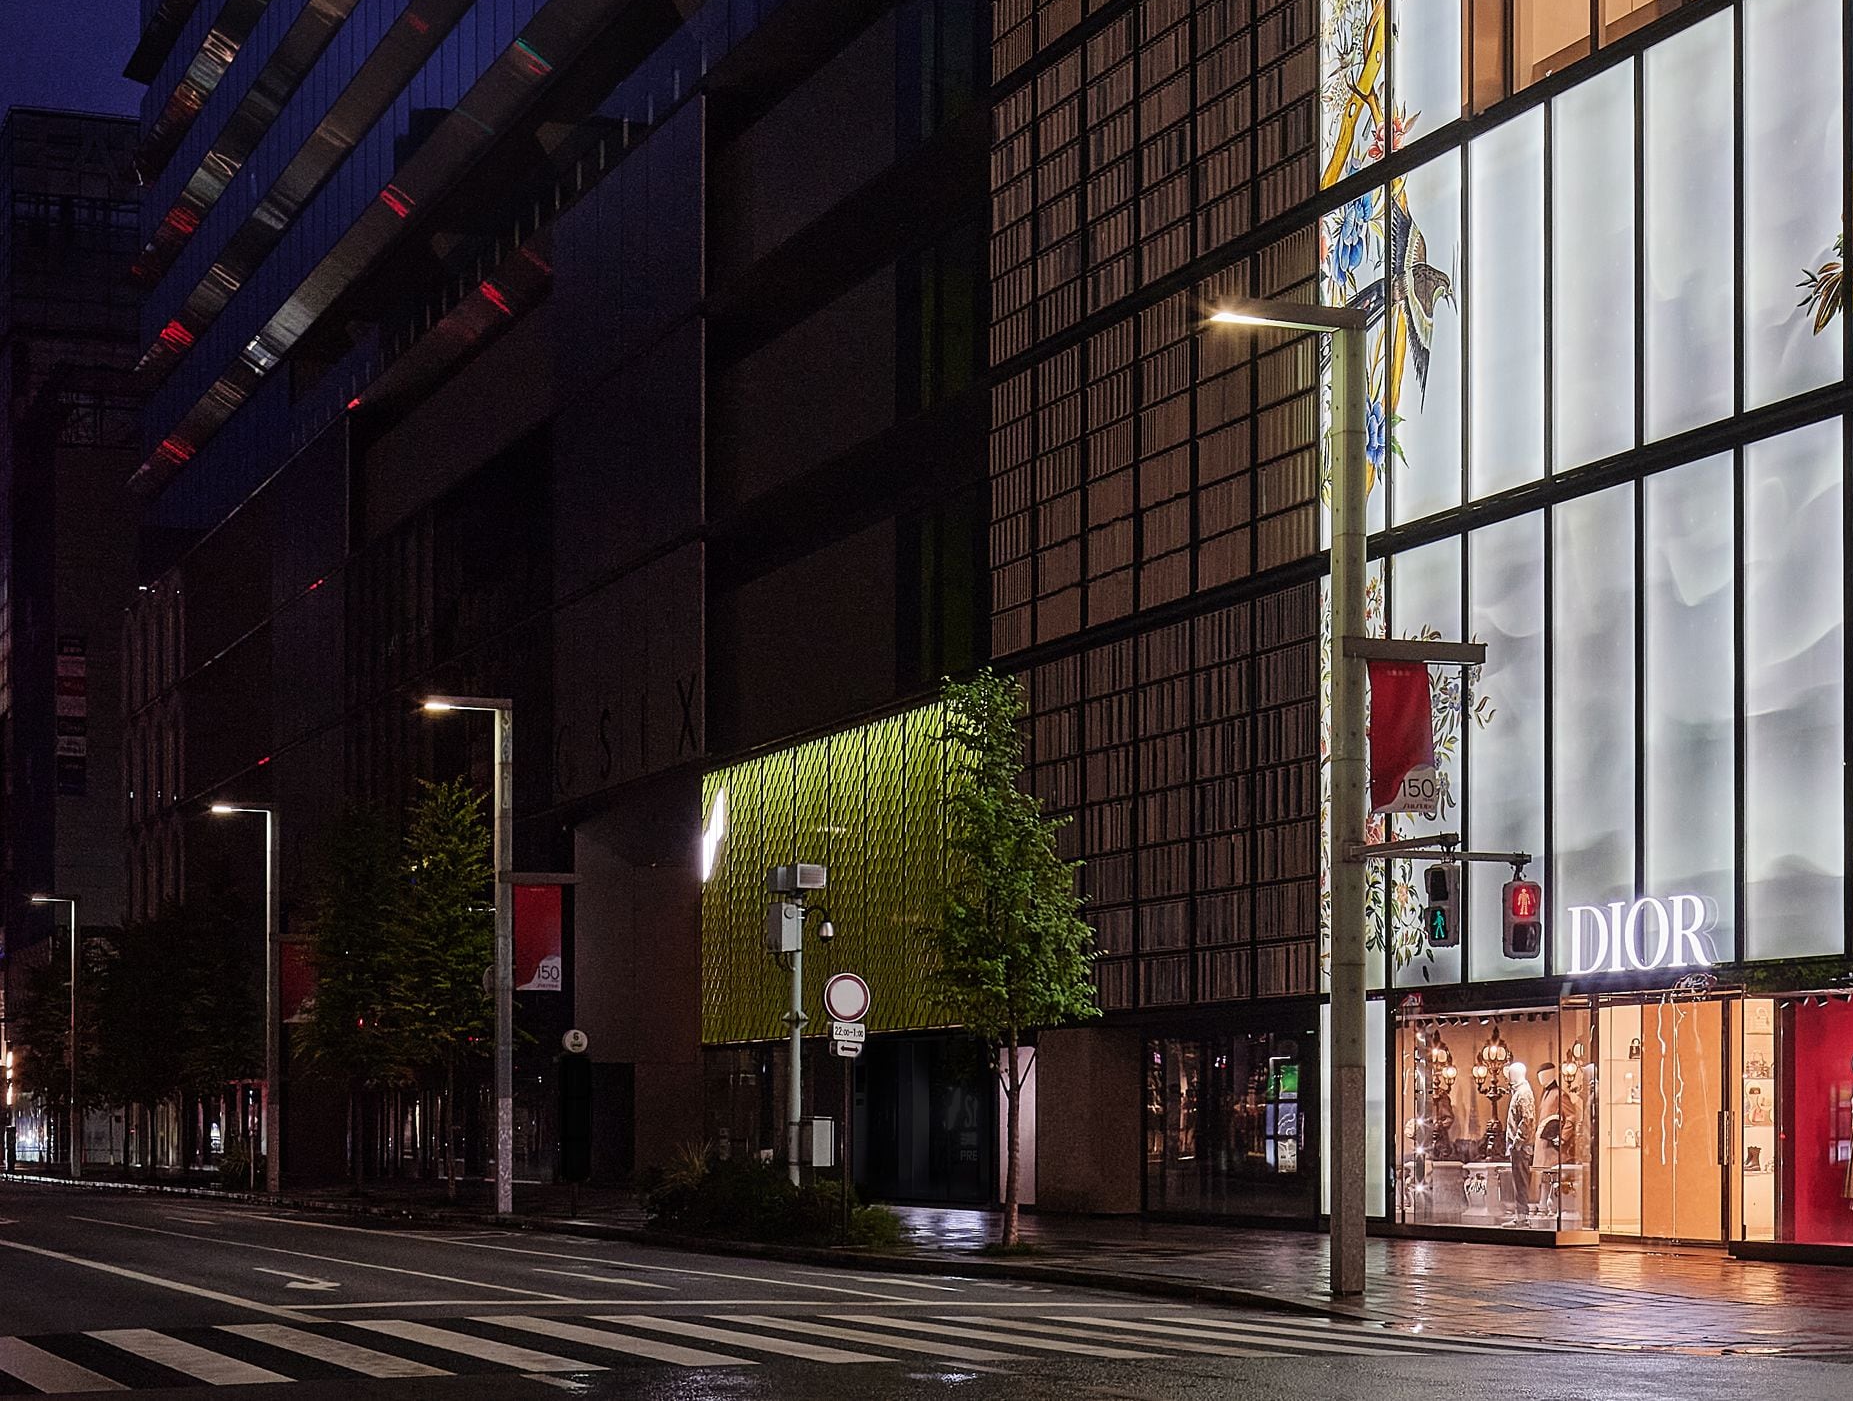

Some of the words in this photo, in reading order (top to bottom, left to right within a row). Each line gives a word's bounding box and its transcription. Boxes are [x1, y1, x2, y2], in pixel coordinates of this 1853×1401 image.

[1402, 779, 1434, 798] 150
[1566, 895, 1712, 975] DIOR
[537, 966, 560, 980] 150
